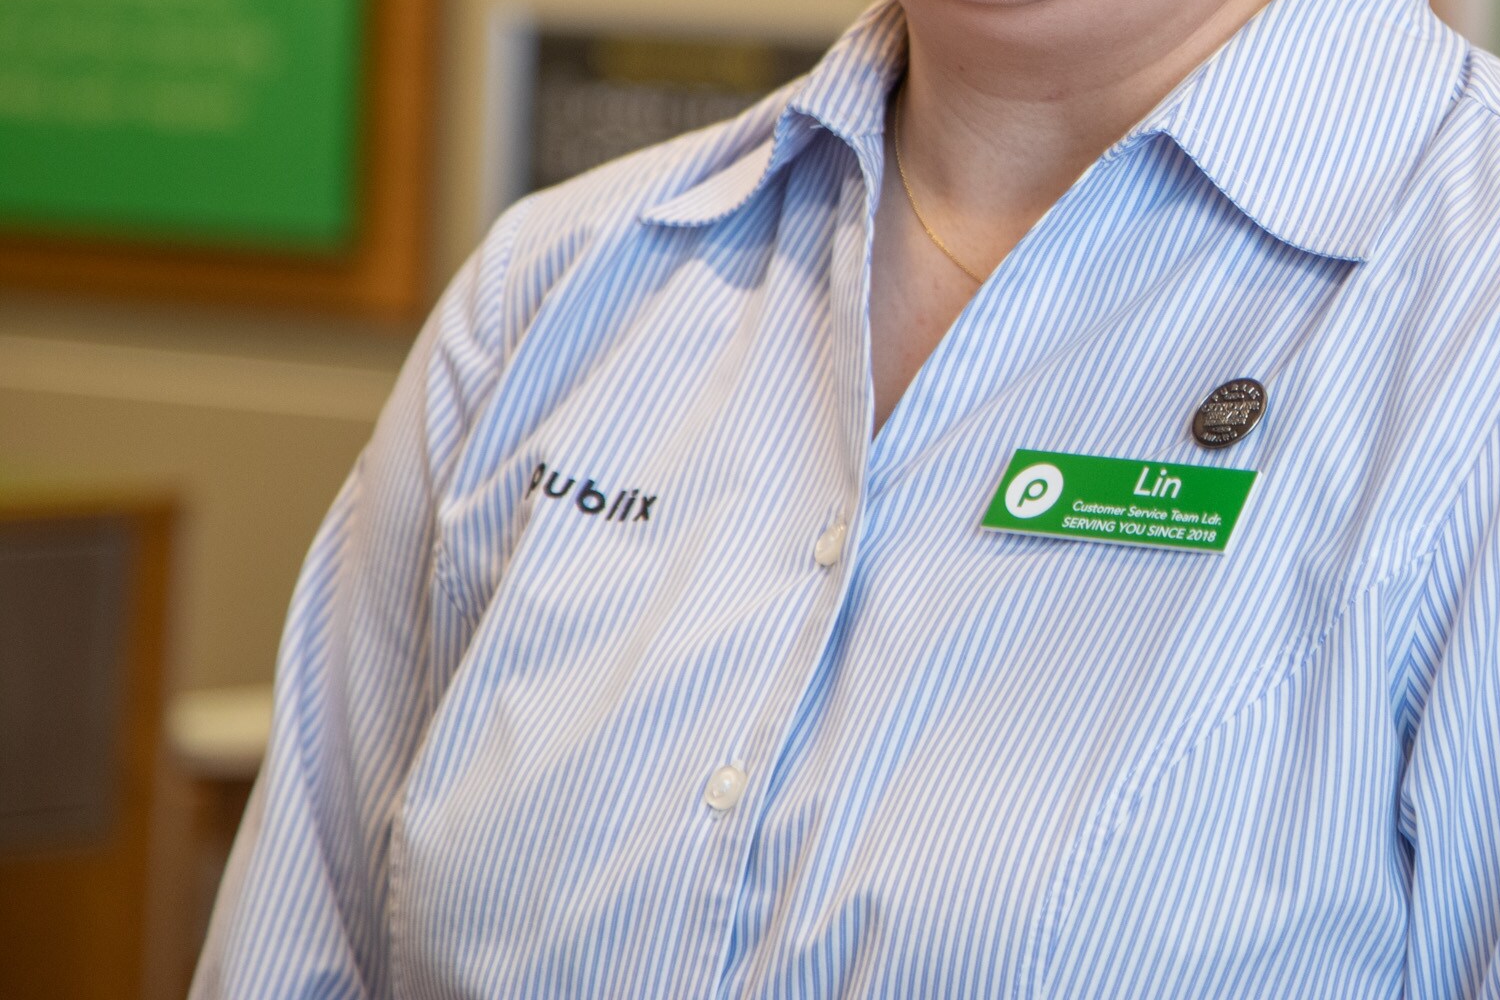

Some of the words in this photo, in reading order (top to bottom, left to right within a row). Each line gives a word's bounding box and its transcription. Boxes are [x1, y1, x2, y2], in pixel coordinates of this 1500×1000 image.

[1133, 466, 1182, 499] Lin
[1072, 500, 1126, 516] Customer
[1127, 505, 1168, 520] Service
[1171, 509, 1200, 524] Team
[1201, 513, 1222, 526] Ldr.
[1061, 516, 1116, 533] SERVING
[1118, 521, 1146, 536] YOU
[1147, 525, 1187, 540] SINCE
[1186, 529, 1217, 543] 2018
